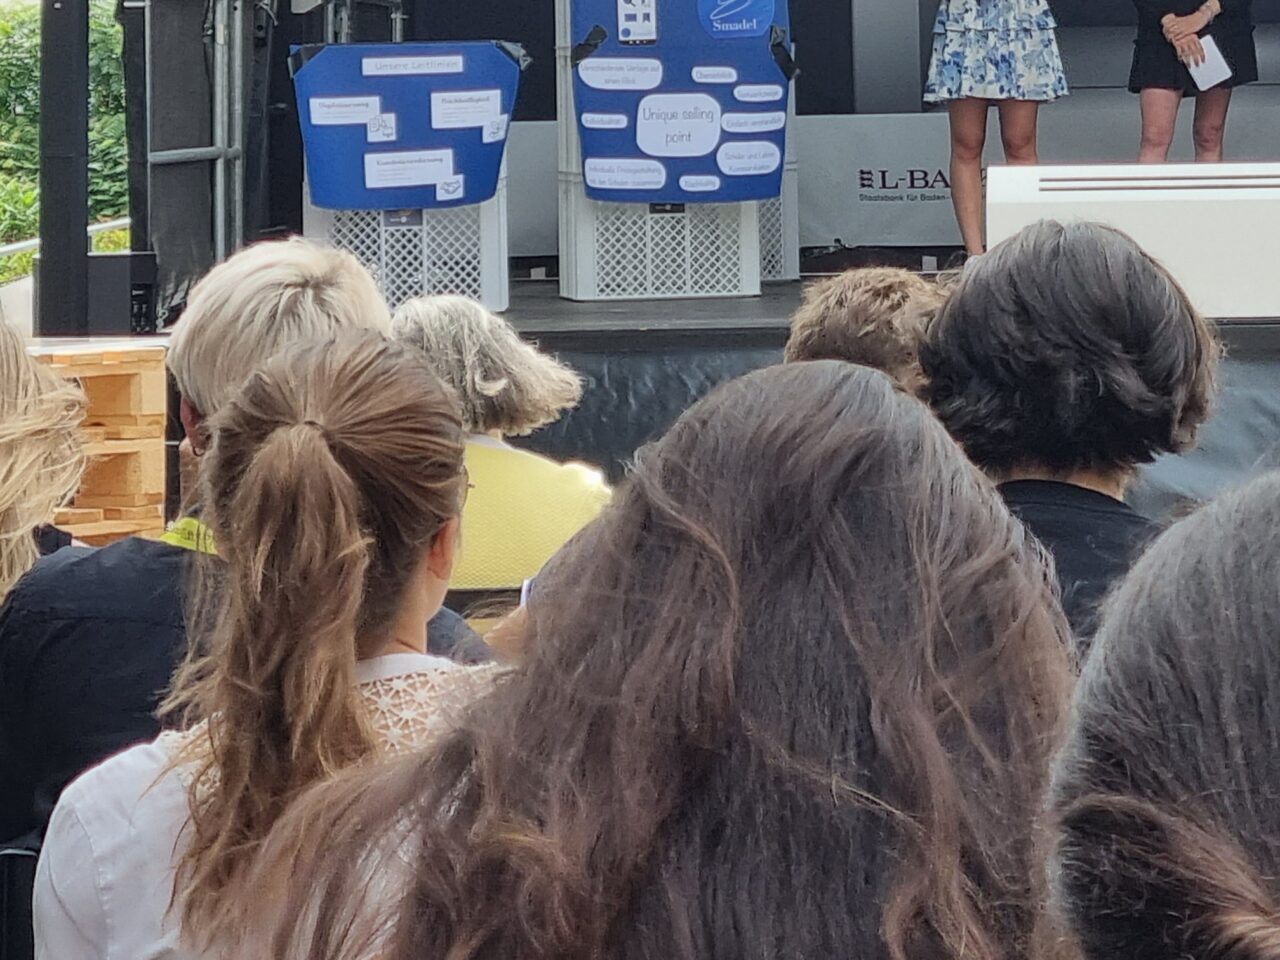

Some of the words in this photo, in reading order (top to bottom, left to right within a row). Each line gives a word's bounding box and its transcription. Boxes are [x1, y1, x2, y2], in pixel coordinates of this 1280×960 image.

[712, 19, 758, 32] Smadel
[642, 107, 678, 124] Unique
[682, 106, 714, 123] selling
[665, 131, 692, 148] point
